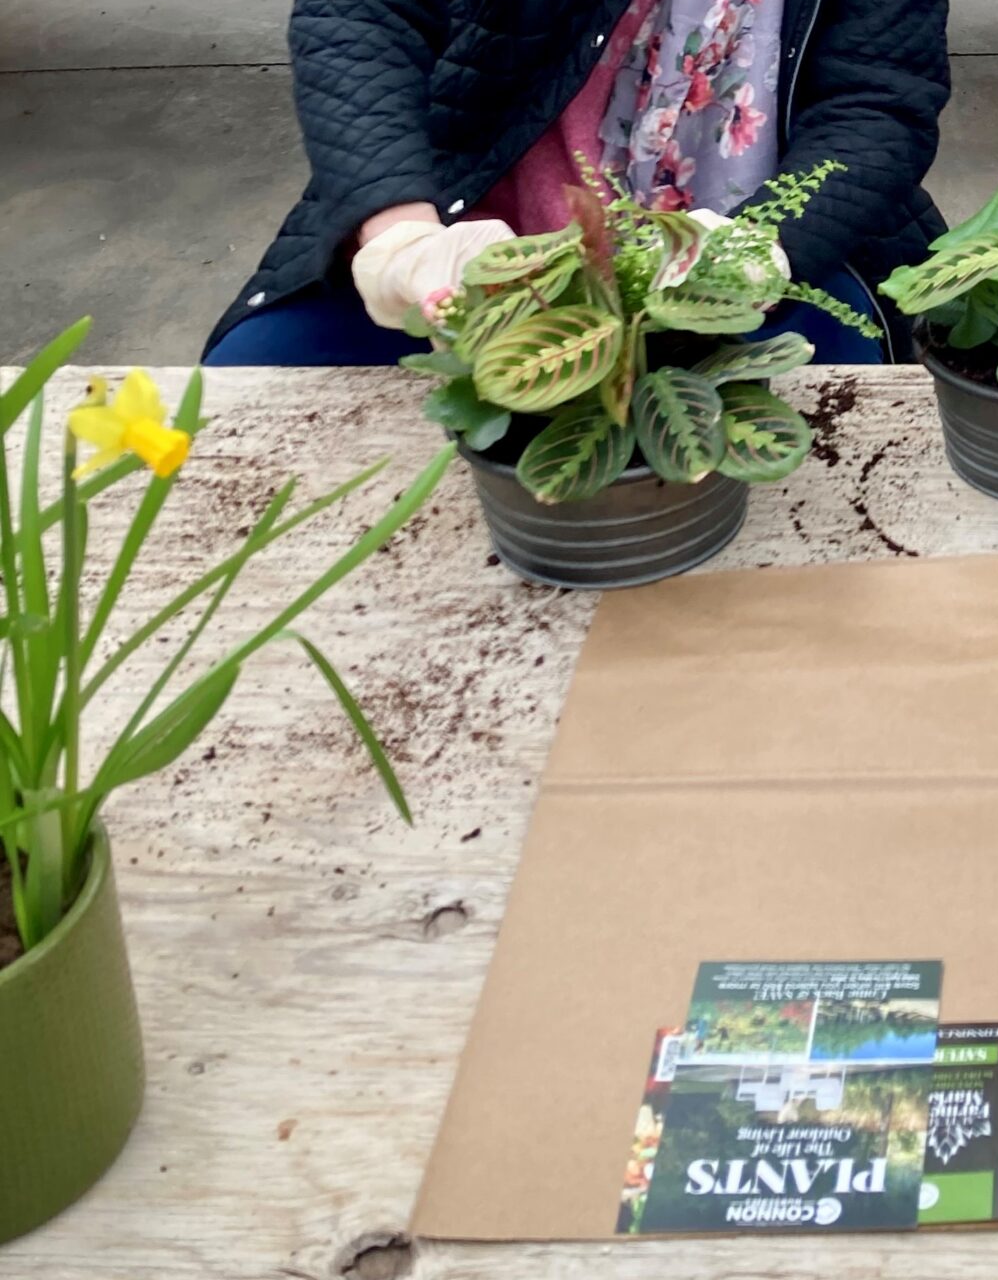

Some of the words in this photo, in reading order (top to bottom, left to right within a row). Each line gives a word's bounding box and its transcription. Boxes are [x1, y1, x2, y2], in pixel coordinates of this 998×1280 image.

[814, 989, 845, 1001] Back
[737, 1126, 785, 1142] Living
[787, 1127, 852, 1142] Outdoor
[750, 1143, 770, 1158] of
[771, 1141, 801, 1156] Life
[805, 1142, 834, 1156] The
[685, 1158, 887, 1195] PLANTS
[725, 1205, 815, 1223] CONNON
